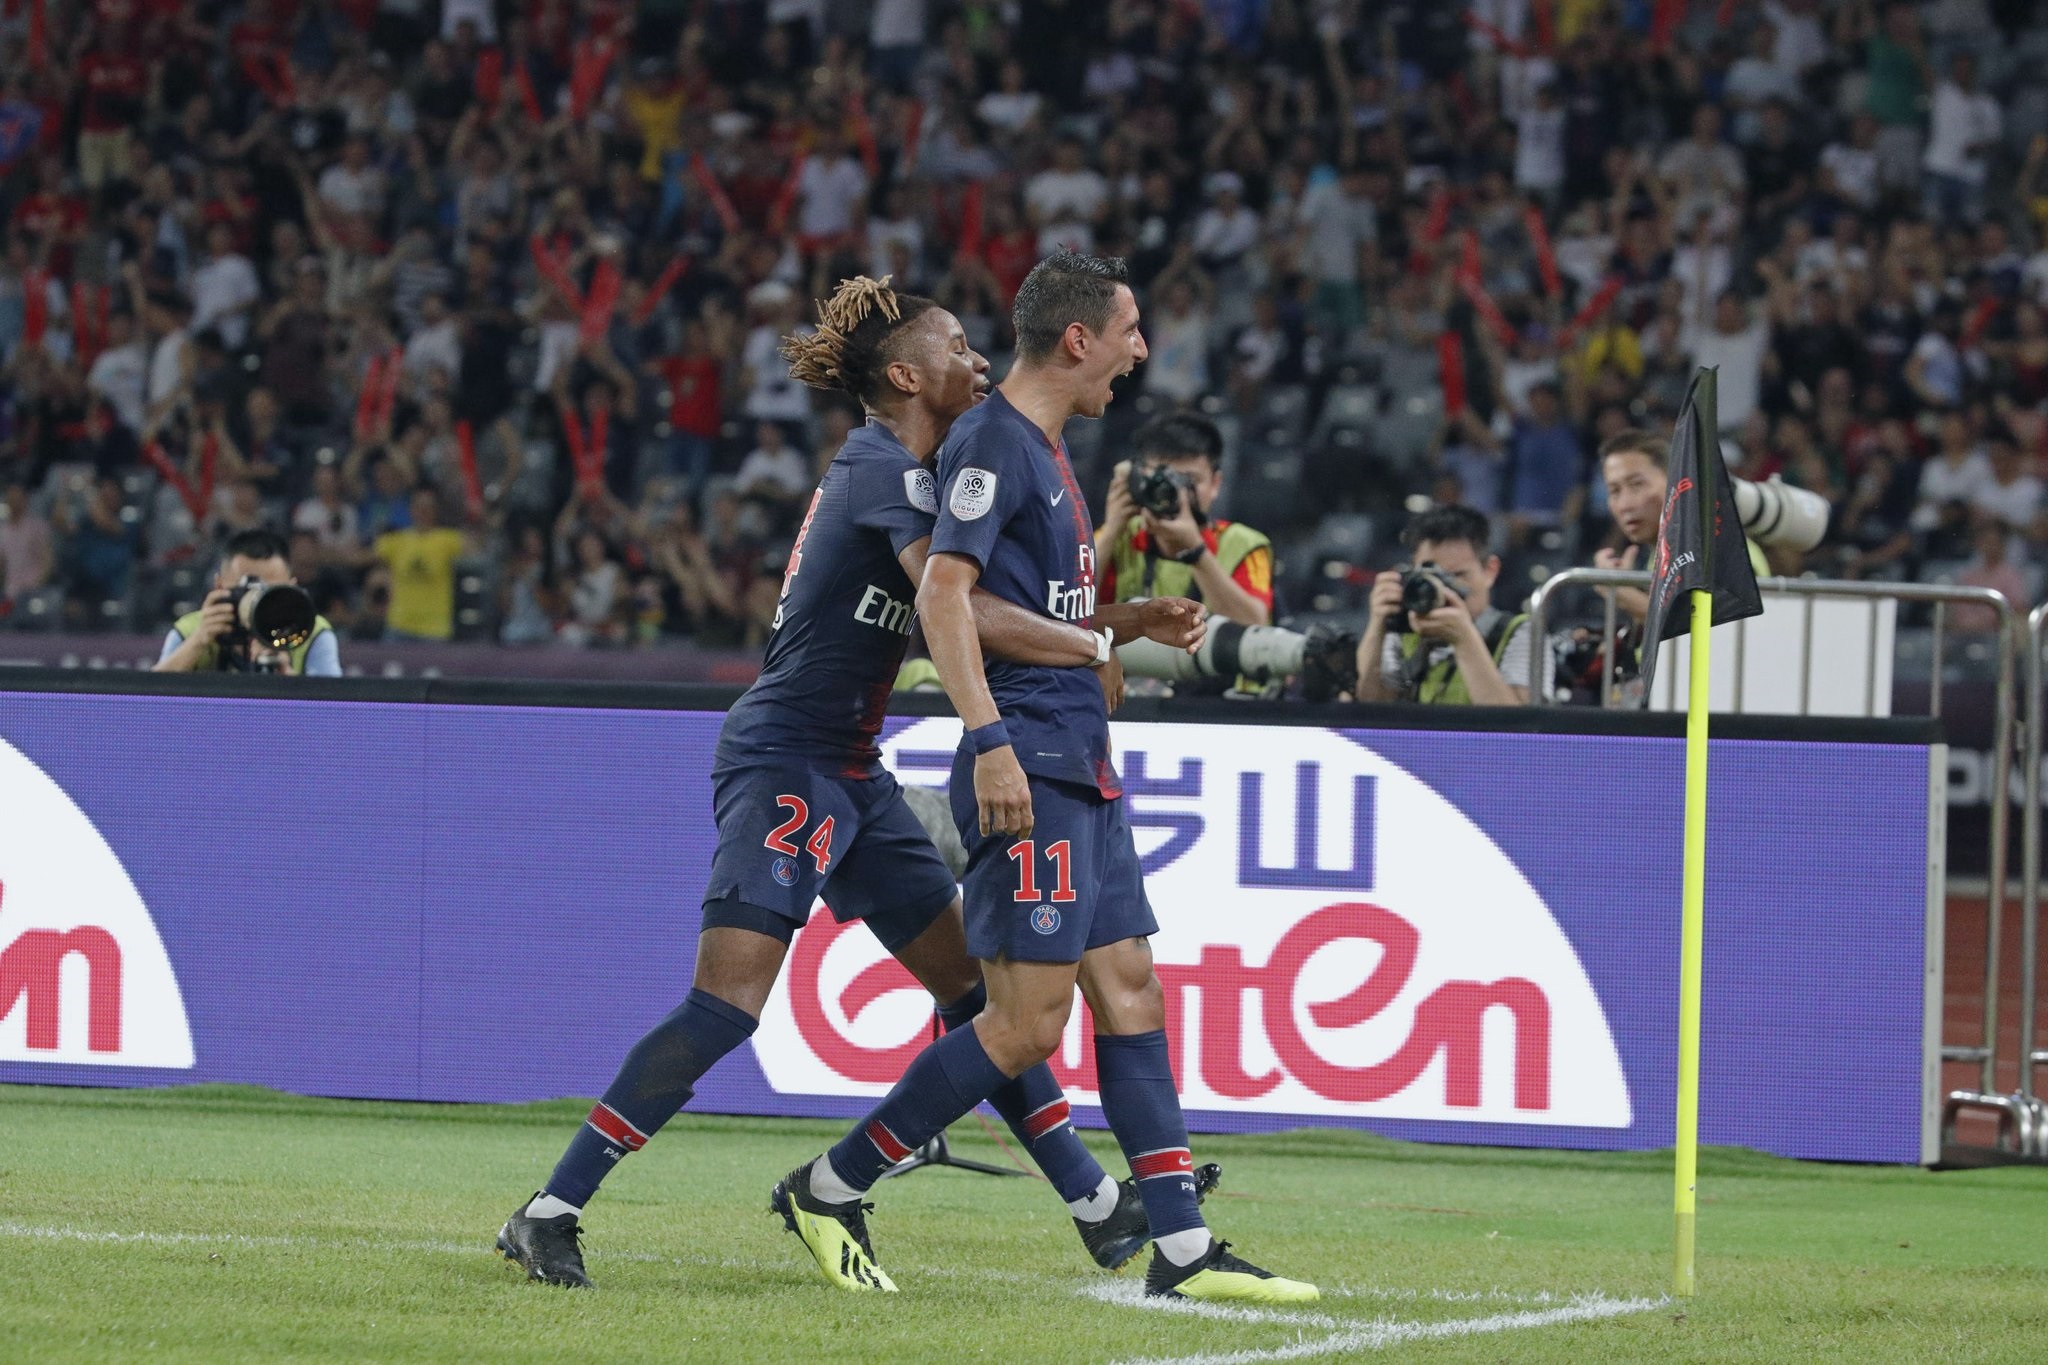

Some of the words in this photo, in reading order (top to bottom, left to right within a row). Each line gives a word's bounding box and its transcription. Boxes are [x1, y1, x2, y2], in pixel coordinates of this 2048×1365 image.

[764, 794, 835, 875] 24
[1007, 840, 1077, 902] 11
[1037, 905, 1057, 915] PARIS
